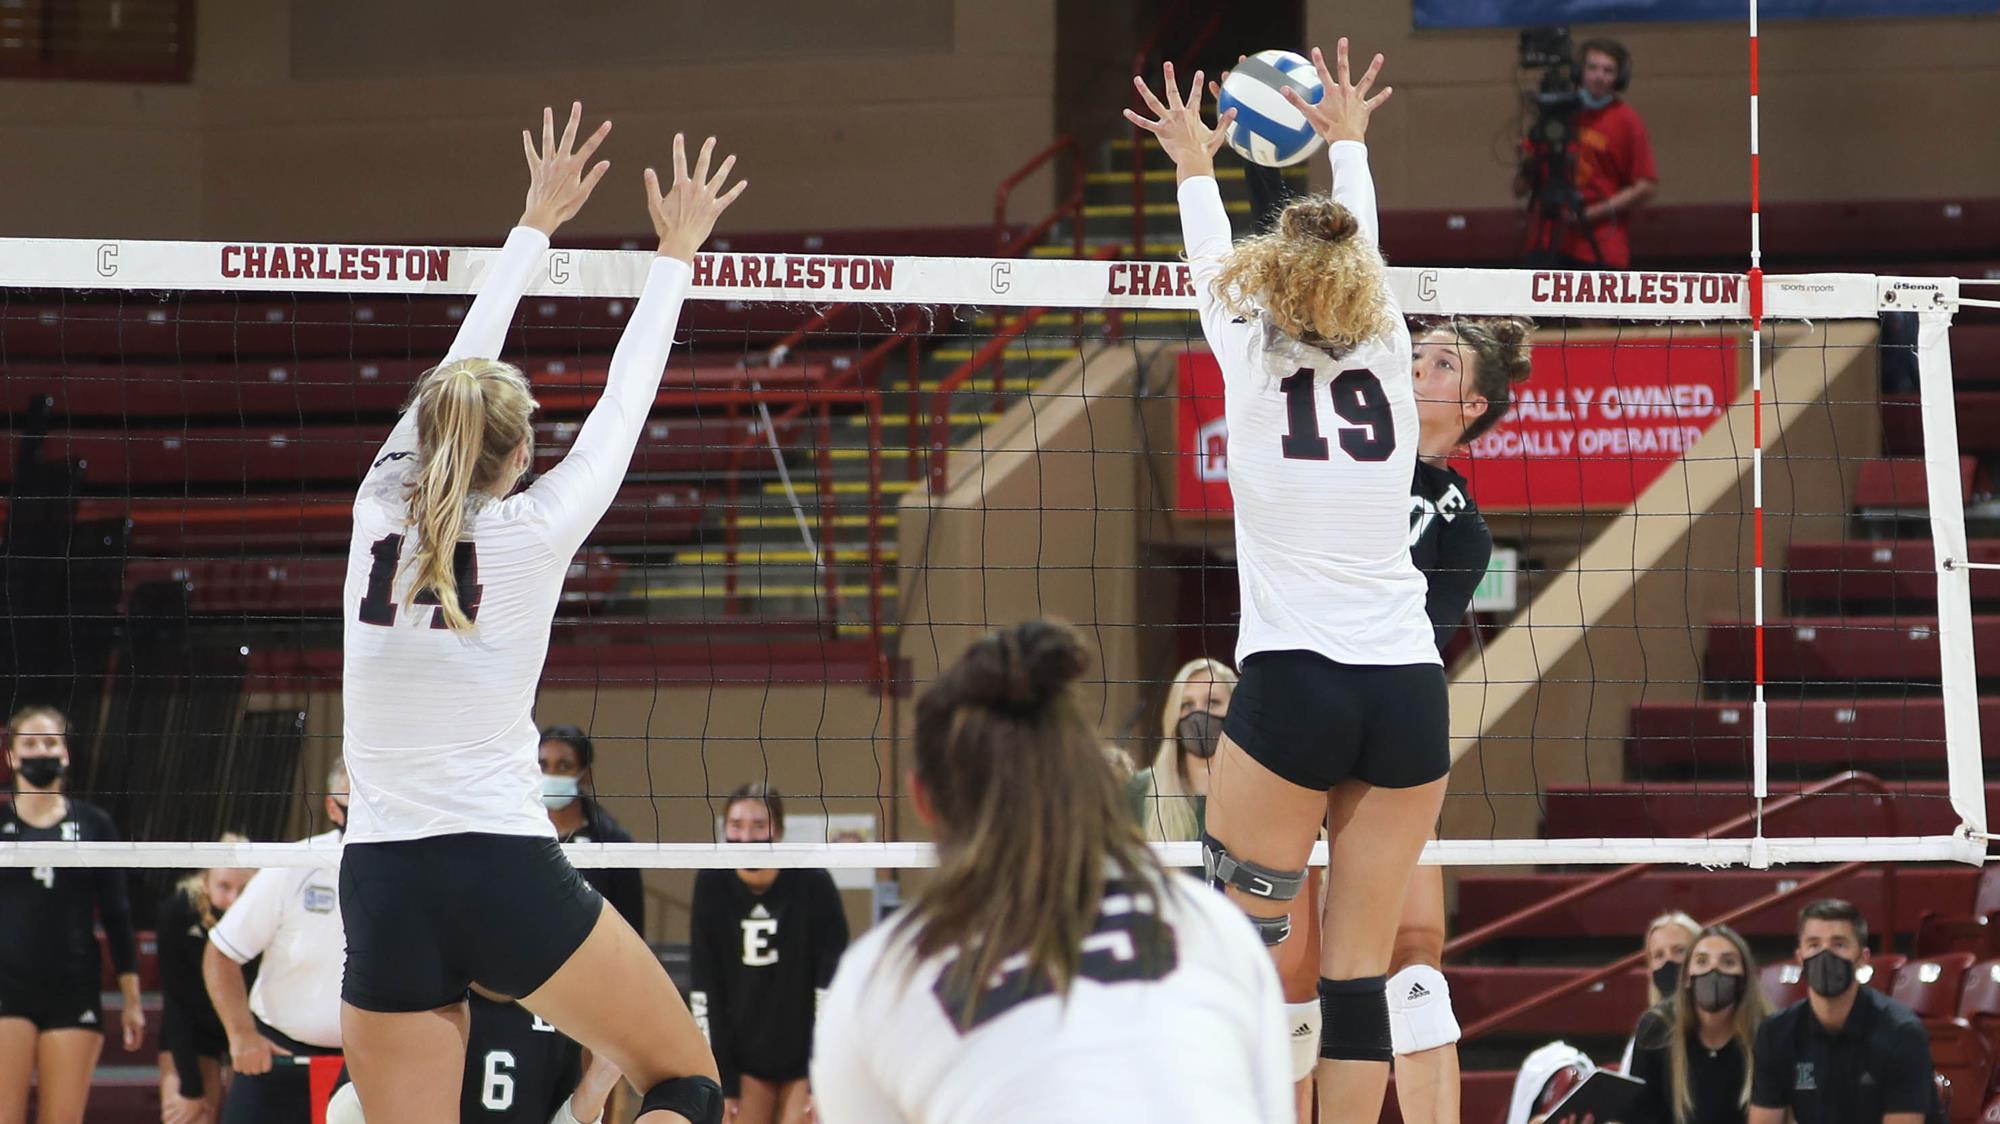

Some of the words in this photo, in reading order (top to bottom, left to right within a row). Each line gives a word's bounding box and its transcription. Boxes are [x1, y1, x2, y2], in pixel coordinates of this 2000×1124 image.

[97, 244, 118, 277] C
[221, 246, 450, 281] CHARLESTON
[550, 252, 570, 284] C
[692, 255, 894, 290] HARLESTON
[990, 262, 1011, 294] C
[1108, 264, 1196, 296] CHAR
[1418, 270, 1438, 301] C
[1531, 271, 1742, 303] CHARLESTON
[1902, 282, 1939, 290] Senoh
[1280, 367, 1396, 462] 19
[1503, 387, 1595, 423] ALLY
[1471, 429, 1575, 458] LOCALLY
[1436, 483, 1467, 523] E
[358, 532, 484, 629] 14
[740, 919, 779, 966] E
[482, 1050, 515, 1110] 6
